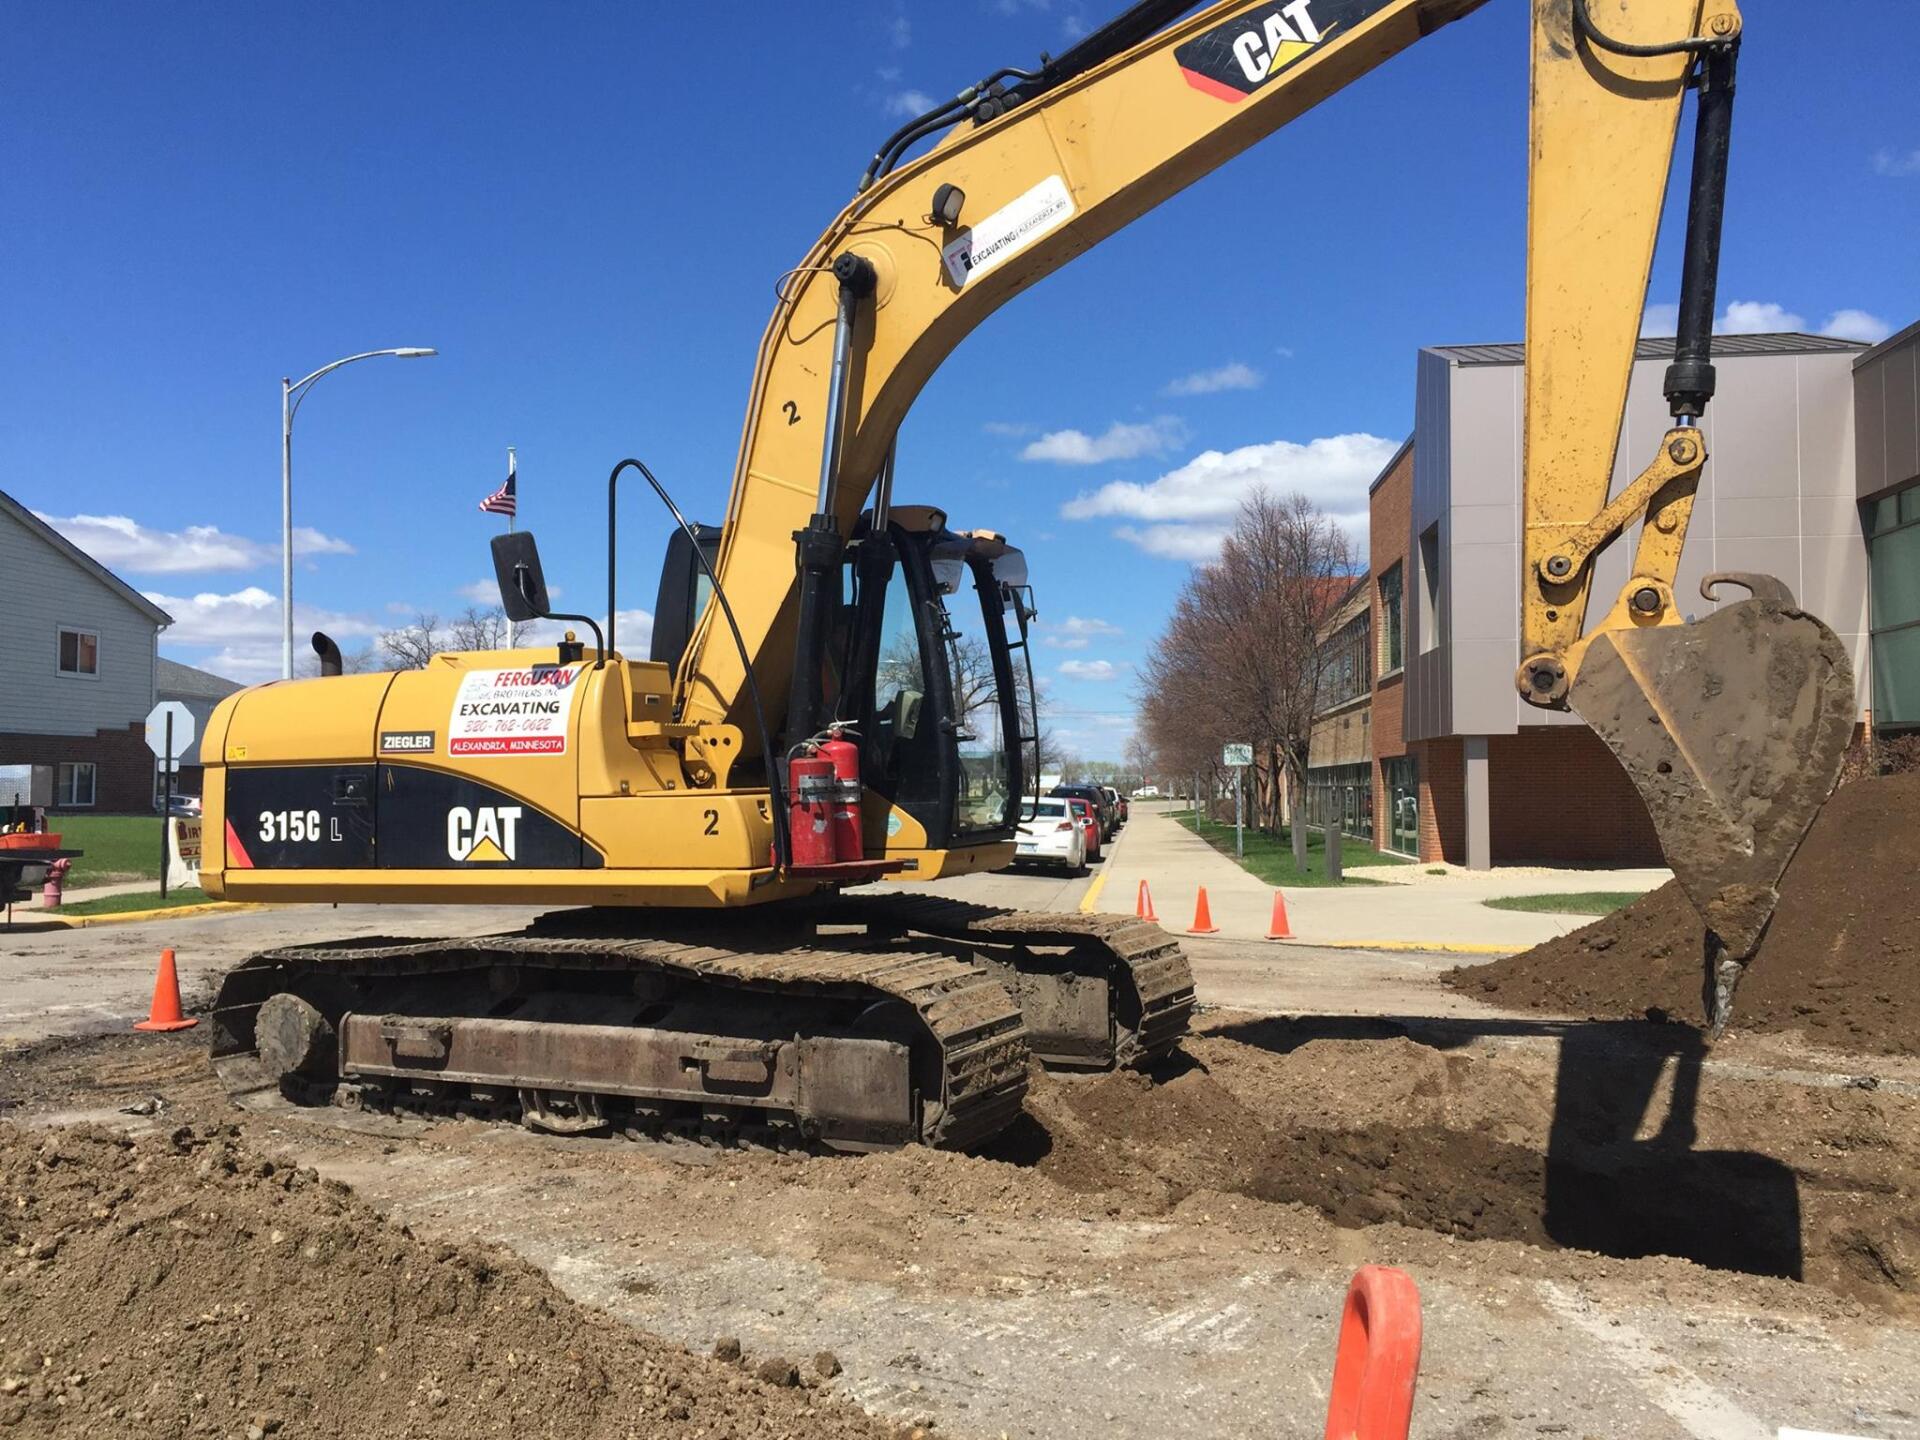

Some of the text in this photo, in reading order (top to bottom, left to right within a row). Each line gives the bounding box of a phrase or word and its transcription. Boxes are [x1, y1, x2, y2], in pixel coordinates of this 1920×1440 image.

[1232, 0, 1322, 83] CAT
[972, 231, 1017, 266] EXCAVATING
[782, 400, 801, 426] 2
[494, 669, 573, 687] FERGUSON
[459, 701, 561, 716] EXCAVATING
[464, 718, 552, 732] 320-762-0622
[383, 735, 431, 749] ZIEGLER
[453, 737, 563, 751] ALEXANDRIA, MINNESOTA
[178, 821, 201, 840] BIR
[259, 810, 342, 842] 315C L
[703, 809, 719, 835] 2
[447, 806, 522, 861] CAT
